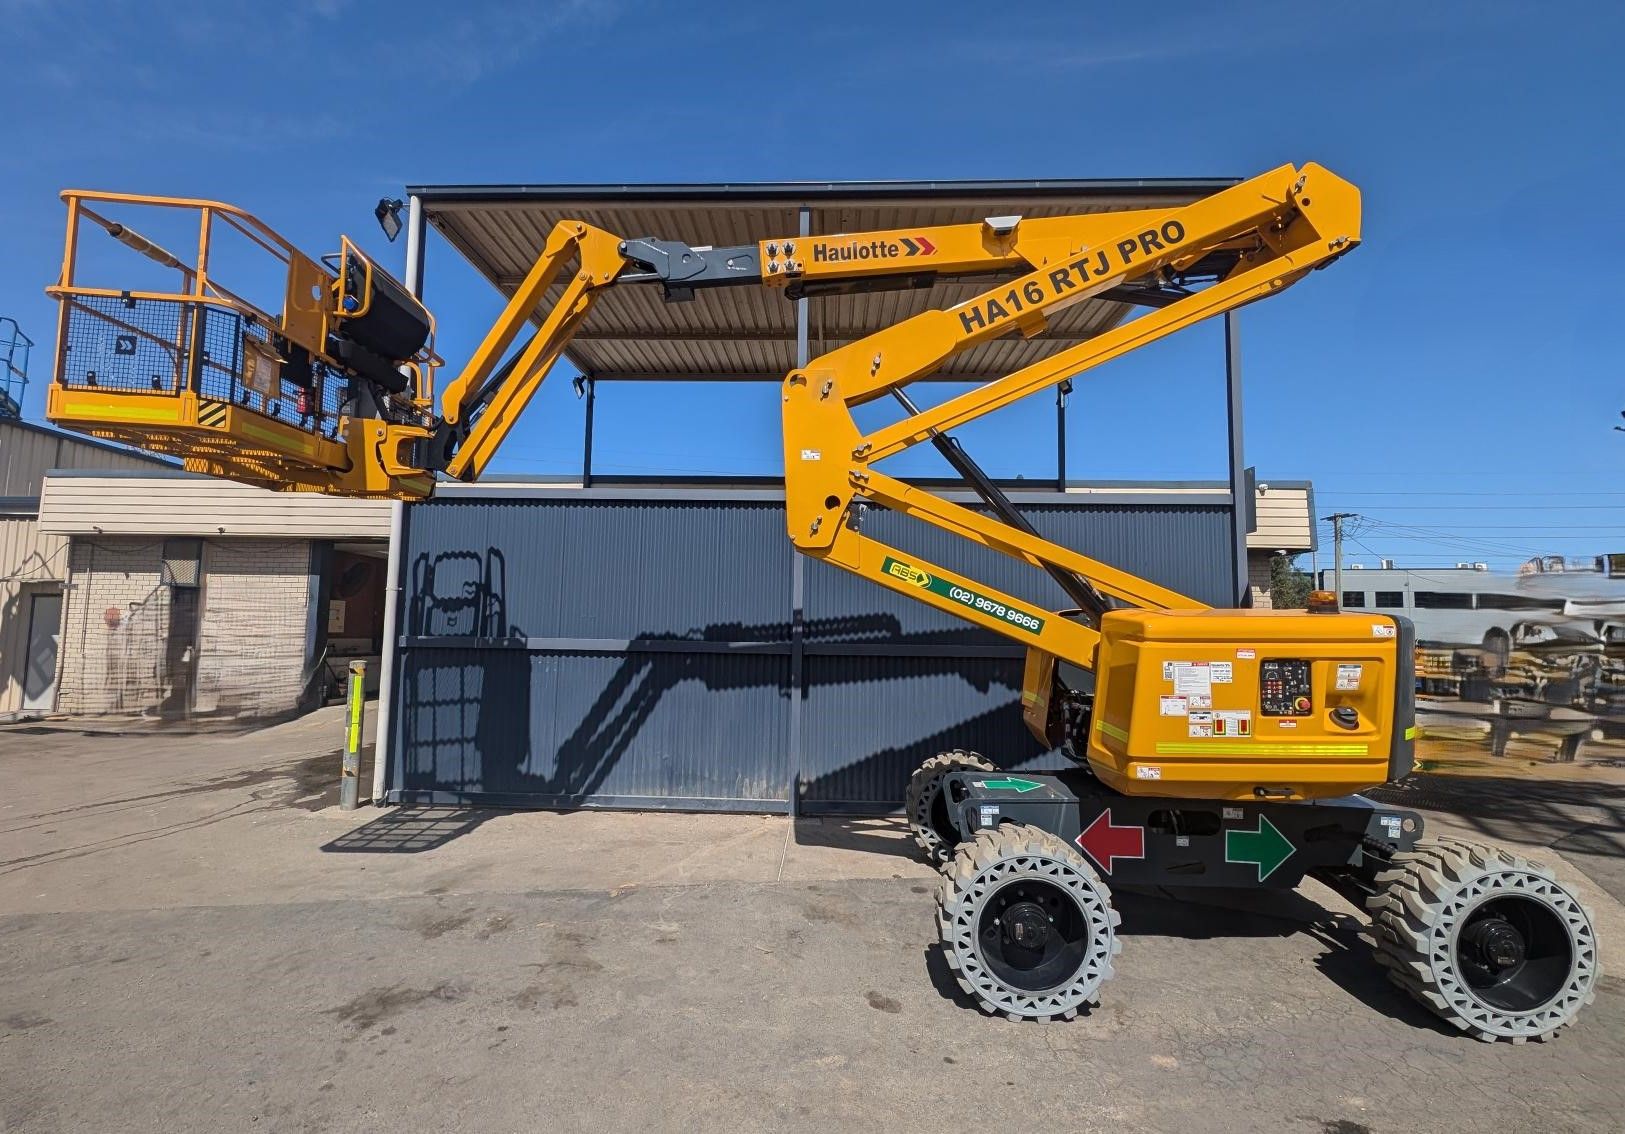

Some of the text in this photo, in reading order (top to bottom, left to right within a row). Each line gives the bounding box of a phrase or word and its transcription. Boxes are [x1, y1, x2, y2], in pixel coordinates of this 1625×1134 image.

[813, 241, 899, 262] Haulotte
[958, 220, 1185, 335] HA16 RTJ PRO
[891, 563, 918, 581] ABS
[949, 586, 1040, 630] (02) 9678 9666
